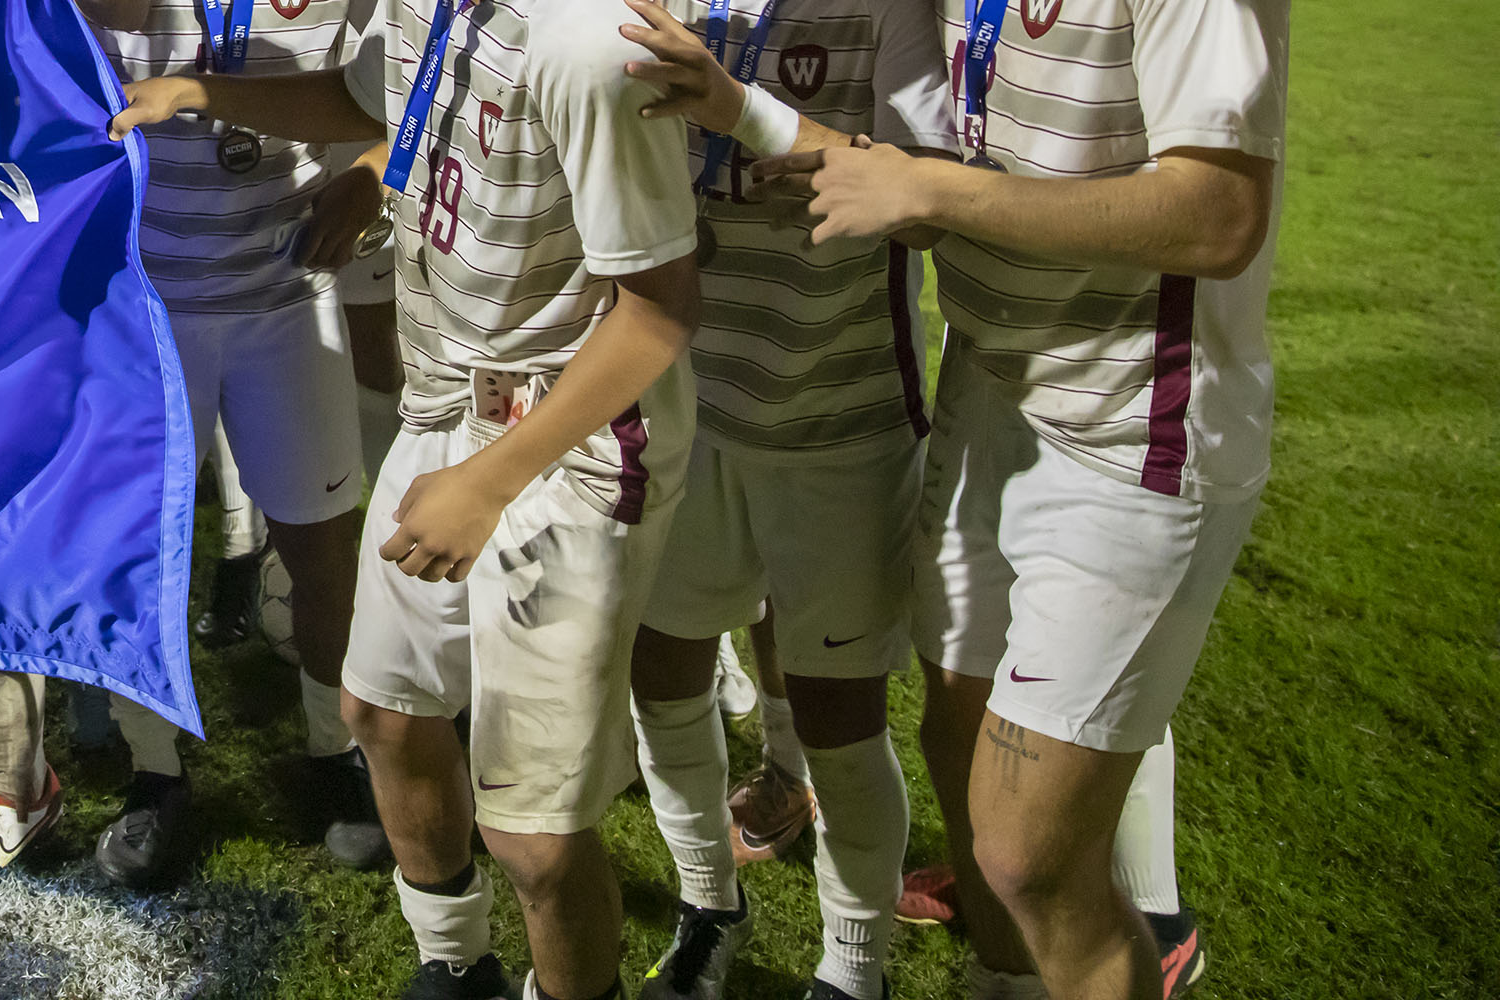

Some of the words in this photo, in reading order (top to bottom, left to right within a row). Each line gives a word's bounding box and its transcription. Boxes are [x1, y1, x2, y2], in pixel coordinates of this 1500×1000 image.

[233, 25, 247, 58] NCCAA
[970, 20, 995, 60] NCCAA
[421, 54, 439, 93] NCCAA
[739, 43, 758, 81] NCCAA
[785, 57, 820, 87] W
[399, 115, 419, 151] NCCAA
[483, 111, 501, 149] W
[225, 142, 253, 156] NCCAA
